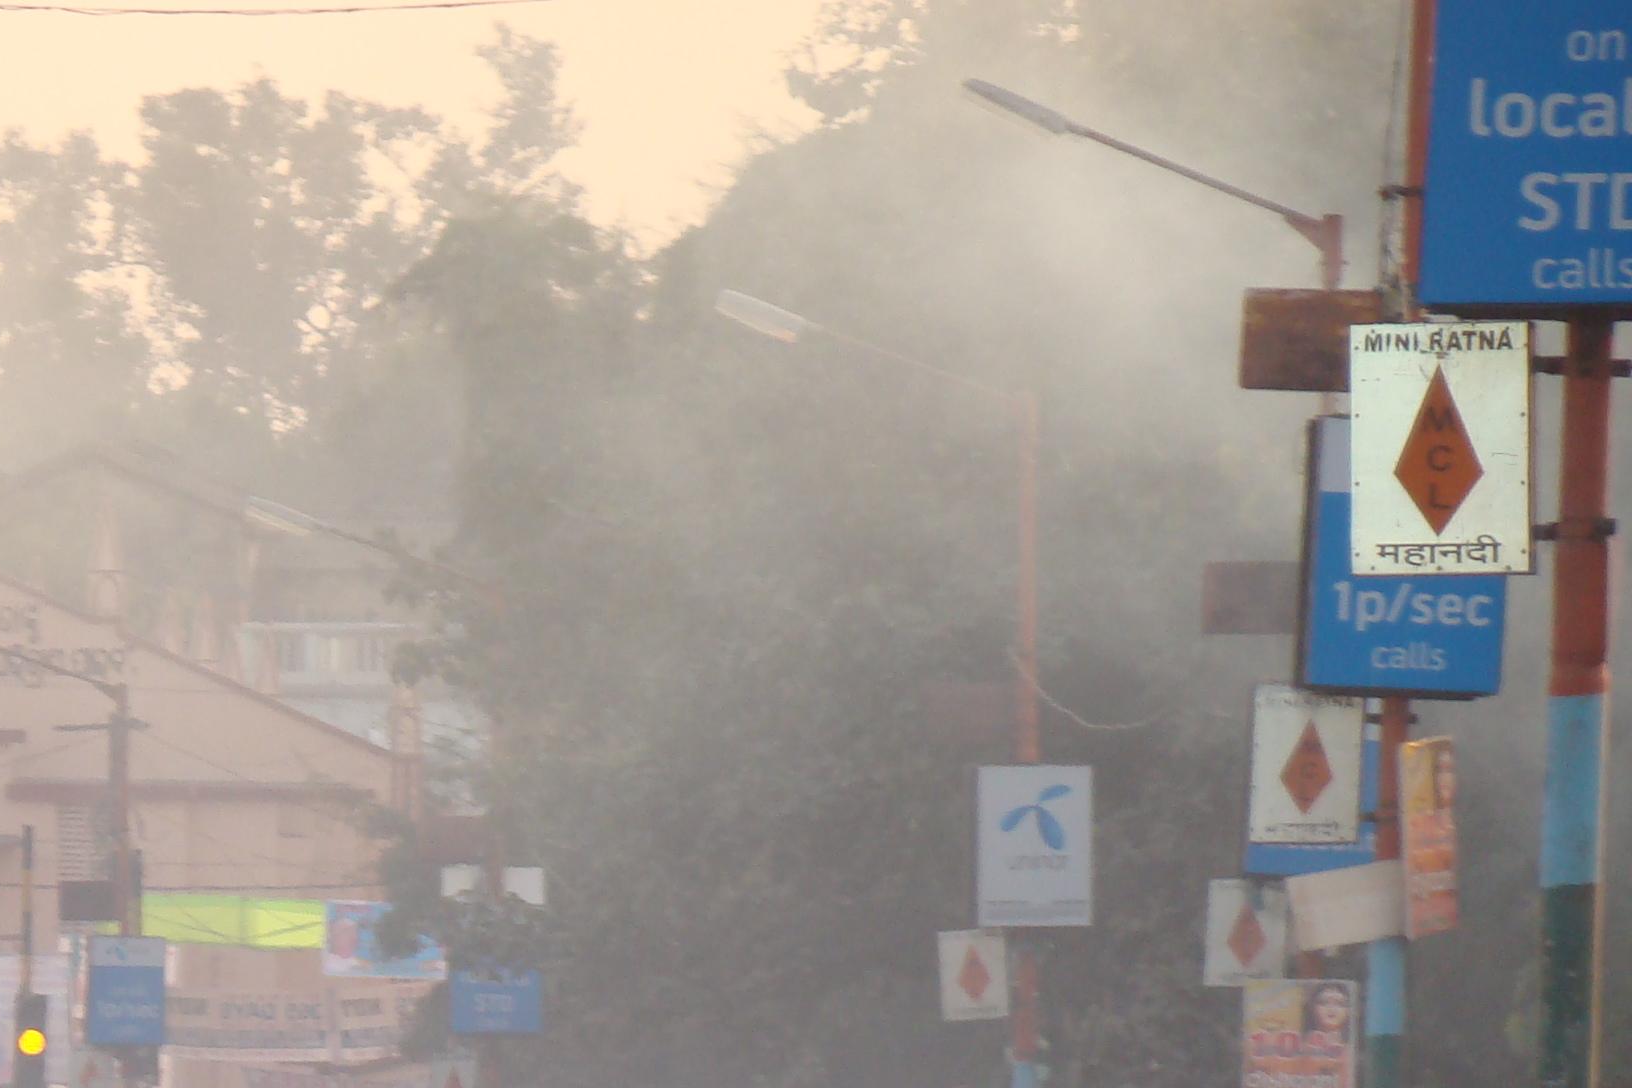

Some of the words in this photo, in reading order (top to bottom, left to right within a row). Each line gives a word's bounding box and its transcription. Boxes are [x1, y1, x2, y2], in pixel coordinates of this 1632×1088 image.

[1567, 29, 1626, 62] on
[1364, 331, 1419, 353] MINI
[1429, 328, 1514, 351] RATNA
[1376, 535, 1502, 566] महानदी
[1333, 581, 1493, 631] 1p/sec
[1370, 641, 1448, 672] calls
